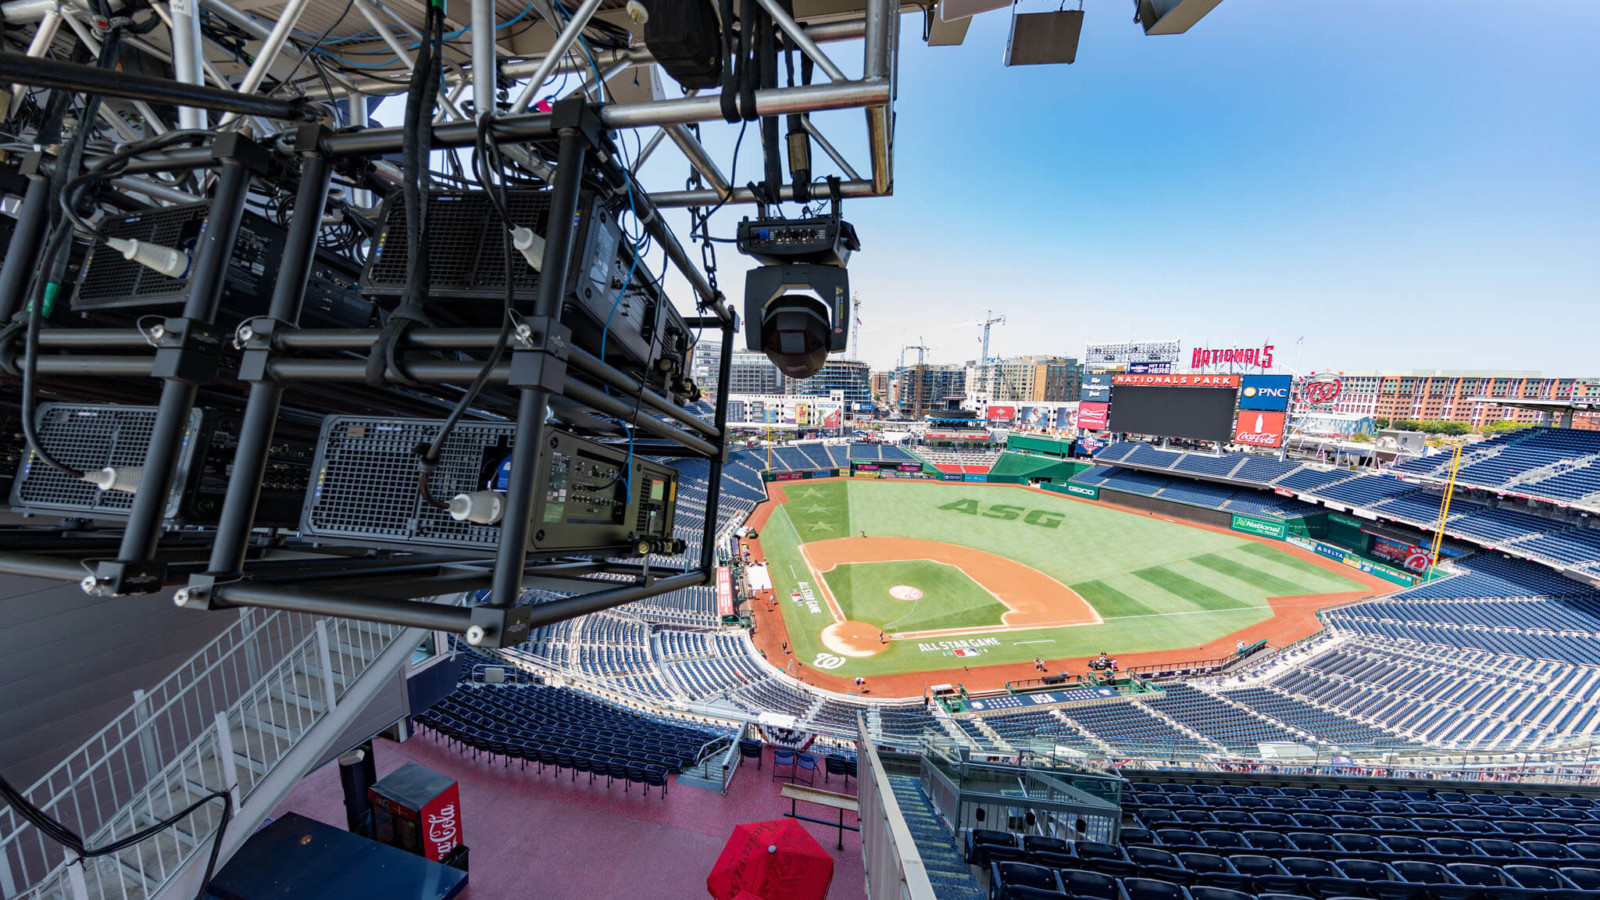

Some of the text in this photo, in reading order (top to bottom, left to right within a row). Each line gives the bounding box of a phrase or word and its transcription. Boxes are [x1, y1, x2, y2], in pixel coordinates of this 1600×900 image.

[1191, 345, 1274, 368] NATIONALS
[1117, 376, 1231, 385] NATIONALS PARK
[1258, 387, 1287, 398] PNC
[1237, 432, 1279, 444] Coca-Cola
[1068, 486, 1095, 496] GEICO
[937, 498, 1066, 529] ASG
[1246, 520, 1281, 533] National
[1323, 547, 1344, 559] DELTA
[1030, 693, 1057, 704] USA
